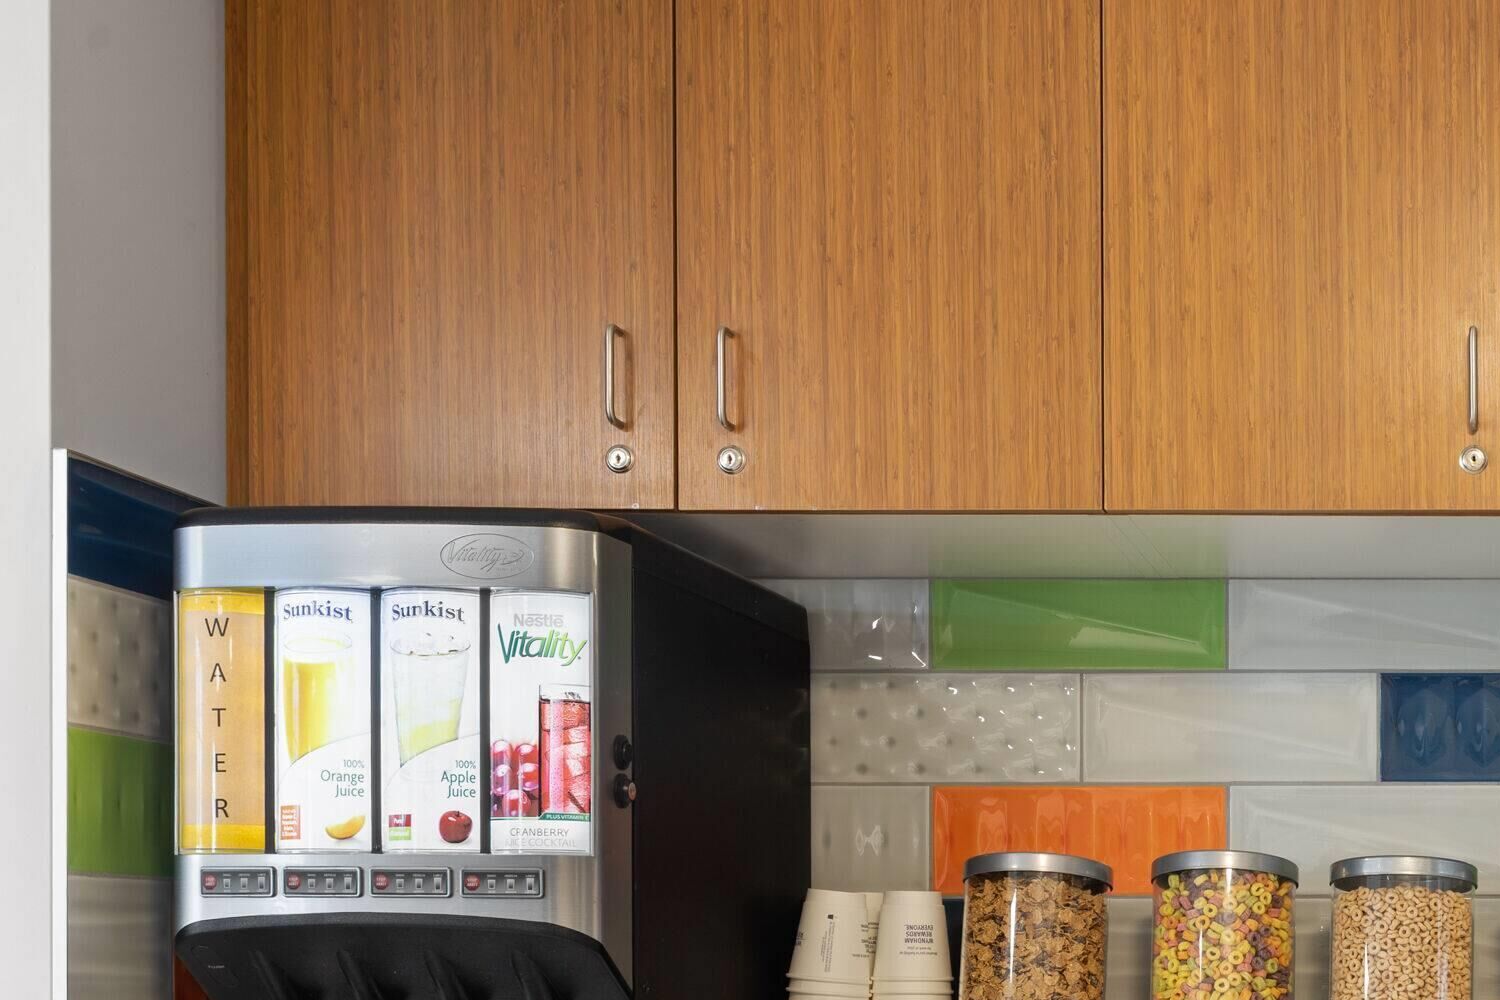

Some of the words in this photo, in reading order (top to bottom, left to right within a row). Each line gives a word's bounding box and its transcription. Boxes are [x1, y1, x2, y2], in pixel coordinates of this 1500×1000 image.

[283, 600, 352, 622] Sunkist
[392, 600, 465, 623] Sunkist
[497, 622, 587, 667] Vitality
[204, 617, 230, 819] WATER
[343, 759, 365, 769] 100%
[455, 759, 476, 769] 100%
[320, 769, 365, 786] Orange
[440, 770, 476, 787] Apple
[335, 784, 365, 798] Juice
[447, 785, 476, 799] Juice
[510, 827, 569, 837] CRANBERRY
